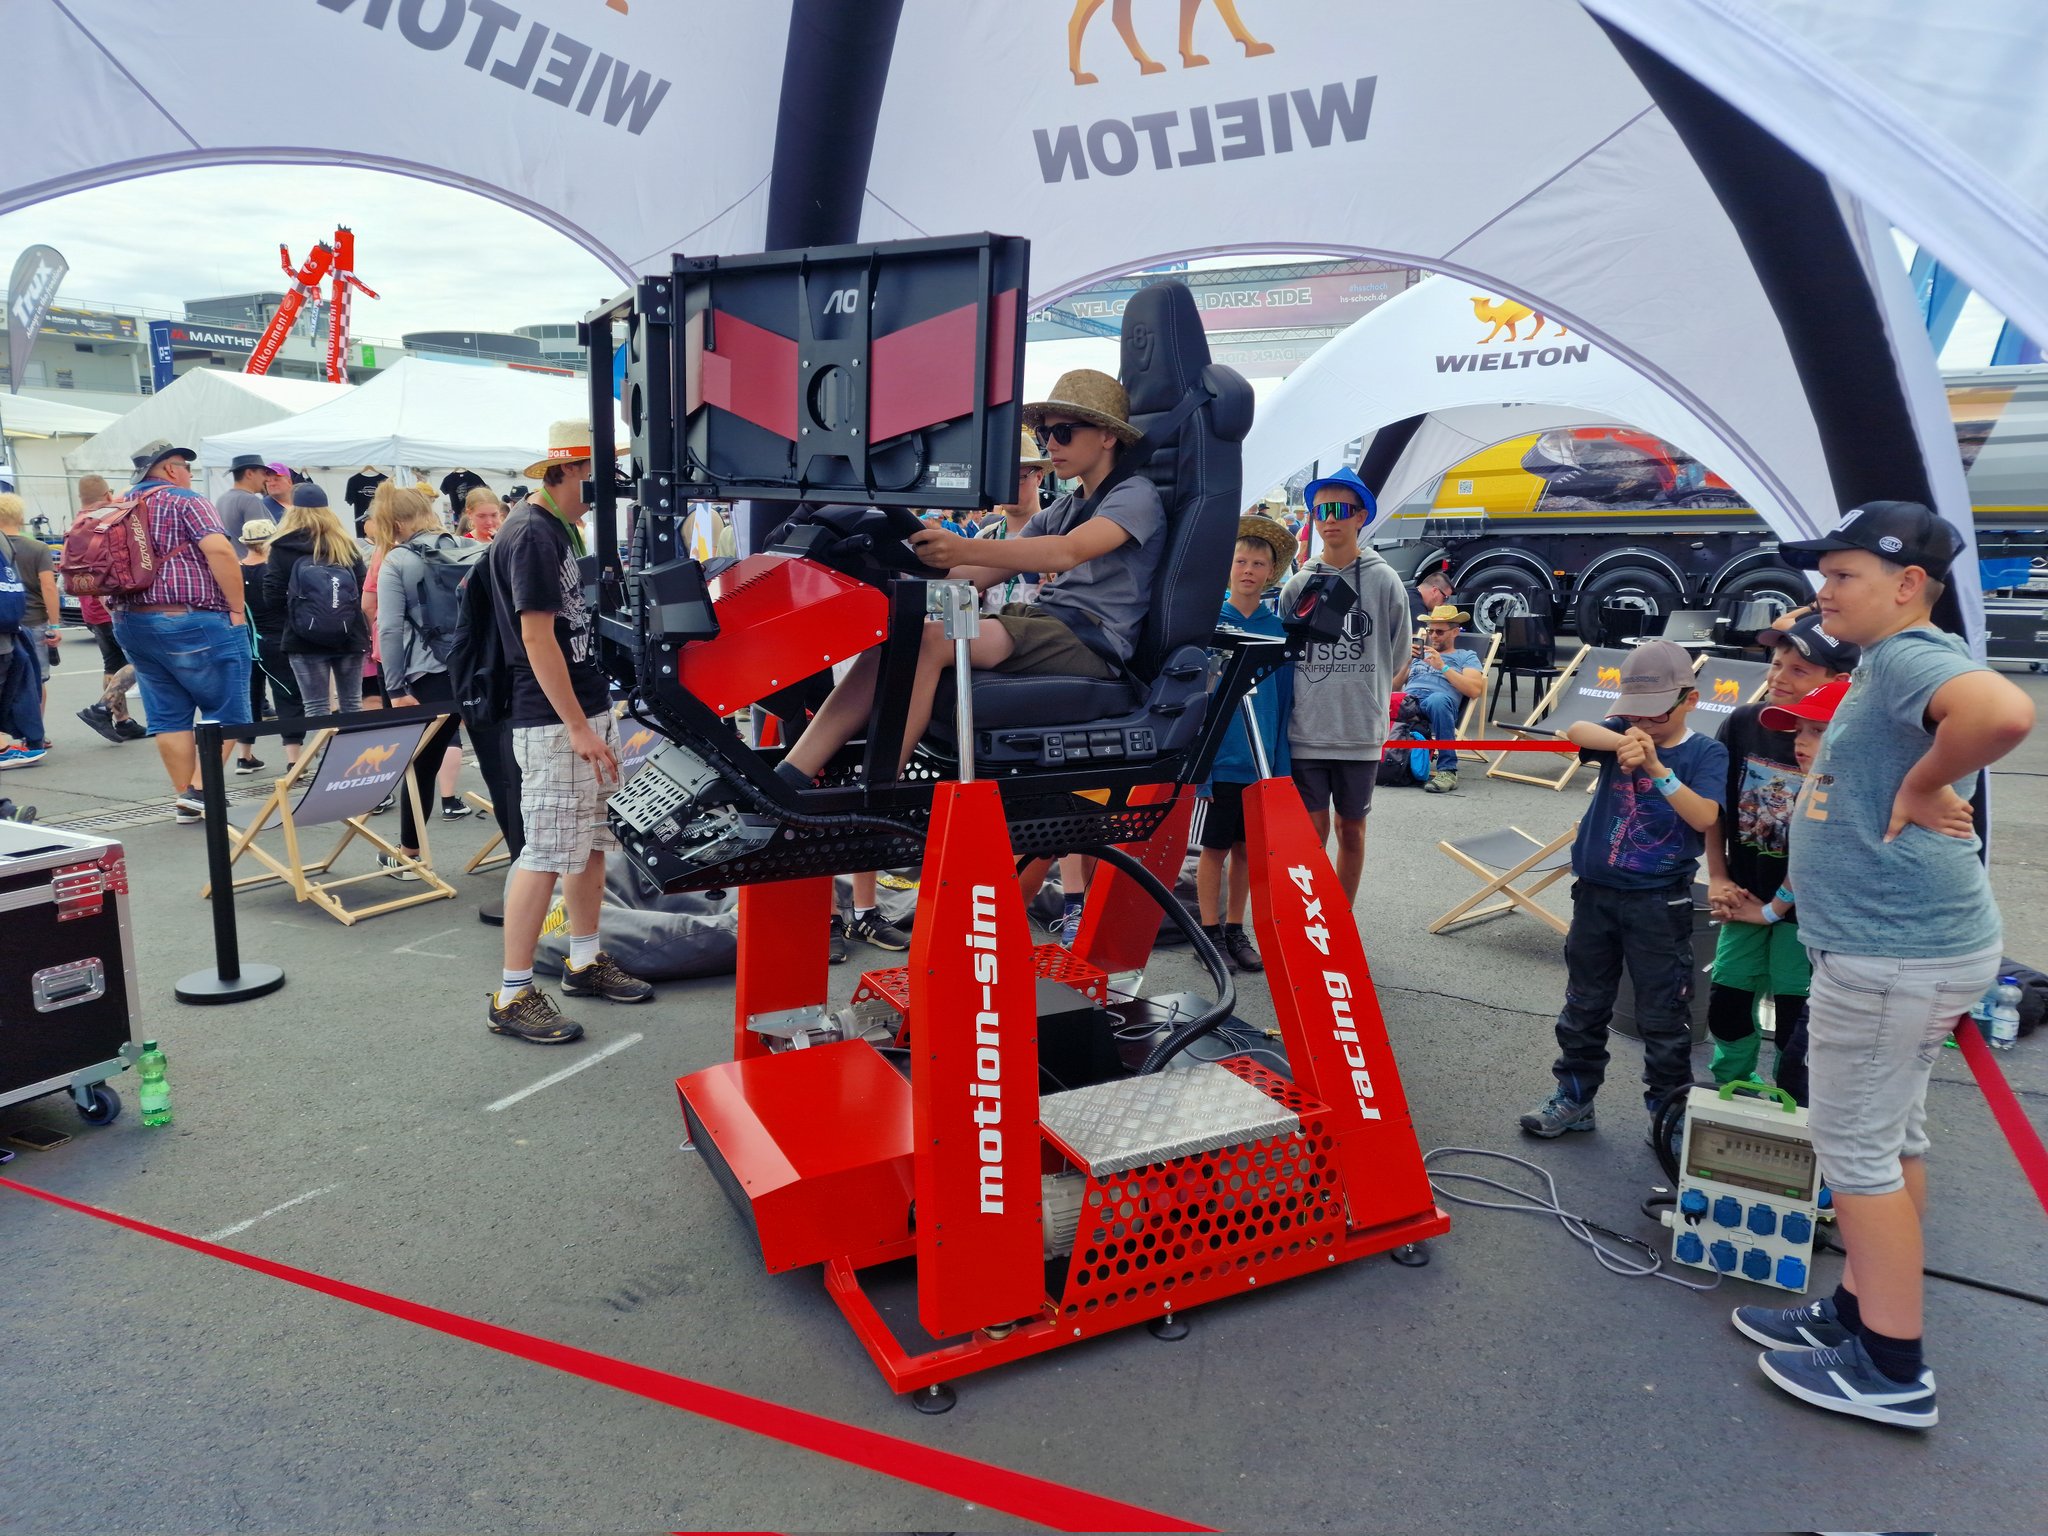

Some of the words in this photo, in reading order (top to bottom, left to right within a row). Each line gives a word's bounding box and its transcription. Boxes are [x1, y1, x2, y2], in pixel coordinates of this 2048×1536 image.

[11, 258, 53, 328] Trux
[823, 289, 877, 314] AO
[1071, 300, 1128, 318] WELC
[1205, 291, 1262, 310] DARK
[1266, 287, 1312, 307] SIDE
[1340, 293, 1388, 304] hs-schoch.de
[189, 330, 261, 348] MANTHEY
[1435, 343, 1591, 373] WIELTON
[332, 581, 340, 609] Columbia
[1317, 642, 1362, 660] SGS
[1298, 663, 1357, 673] SKIFREIZEIT
[1578, 687, 1622, 700] WIELTON
[1288, 864, 1331, 956] 4x4
[965, 884, 1004, 1215] motion-sim
[1322, 970, 1381, 1121] racing
